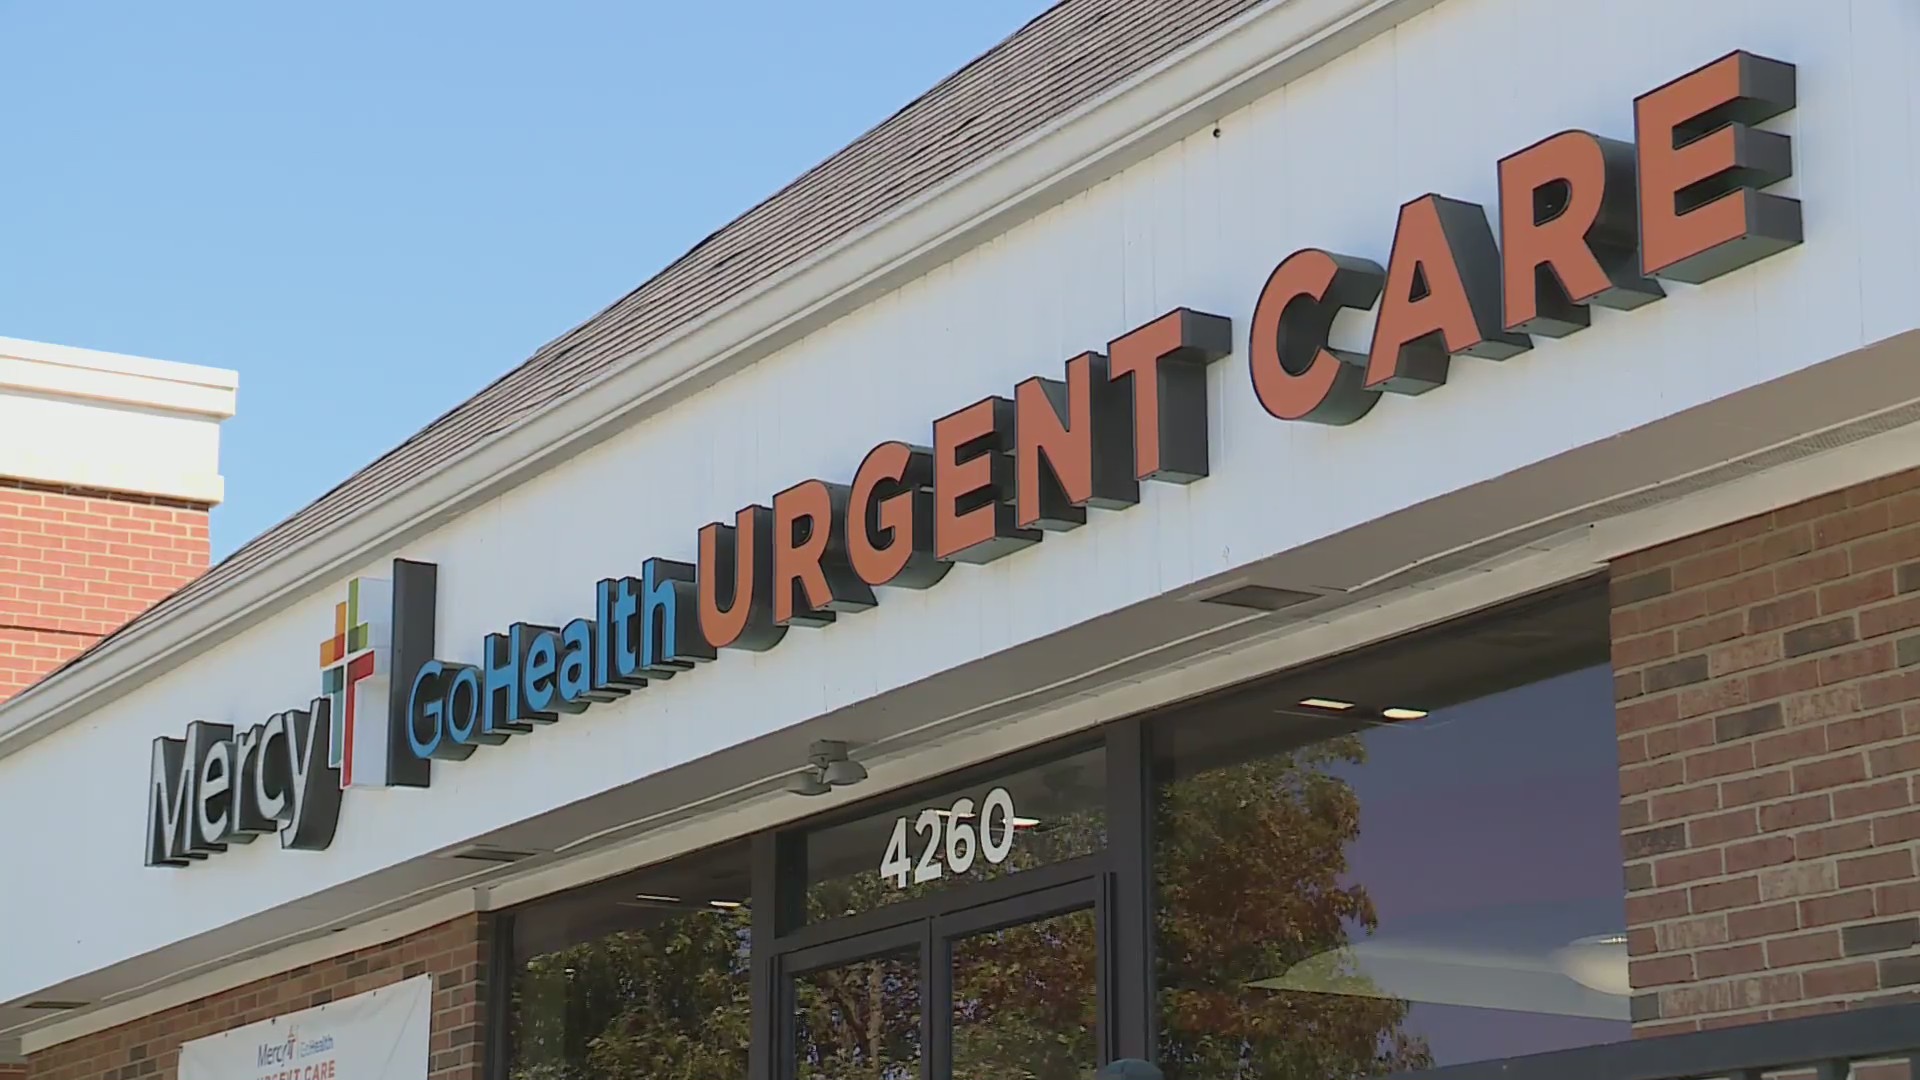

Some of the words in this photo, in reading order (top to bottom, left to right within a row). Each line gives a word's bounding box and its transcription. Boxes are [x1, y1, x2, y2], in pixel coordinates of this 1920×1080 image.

[145, 697, 341, 867] Mercy
[406, 556, 692, 760] GoHealth
[698, 307, 1228, 651] URGENT
[1249, 49, 1802, 426] CARE
[880, 787, 1015, 888] 4260
[304, 1060, 335, 1080] CARE
